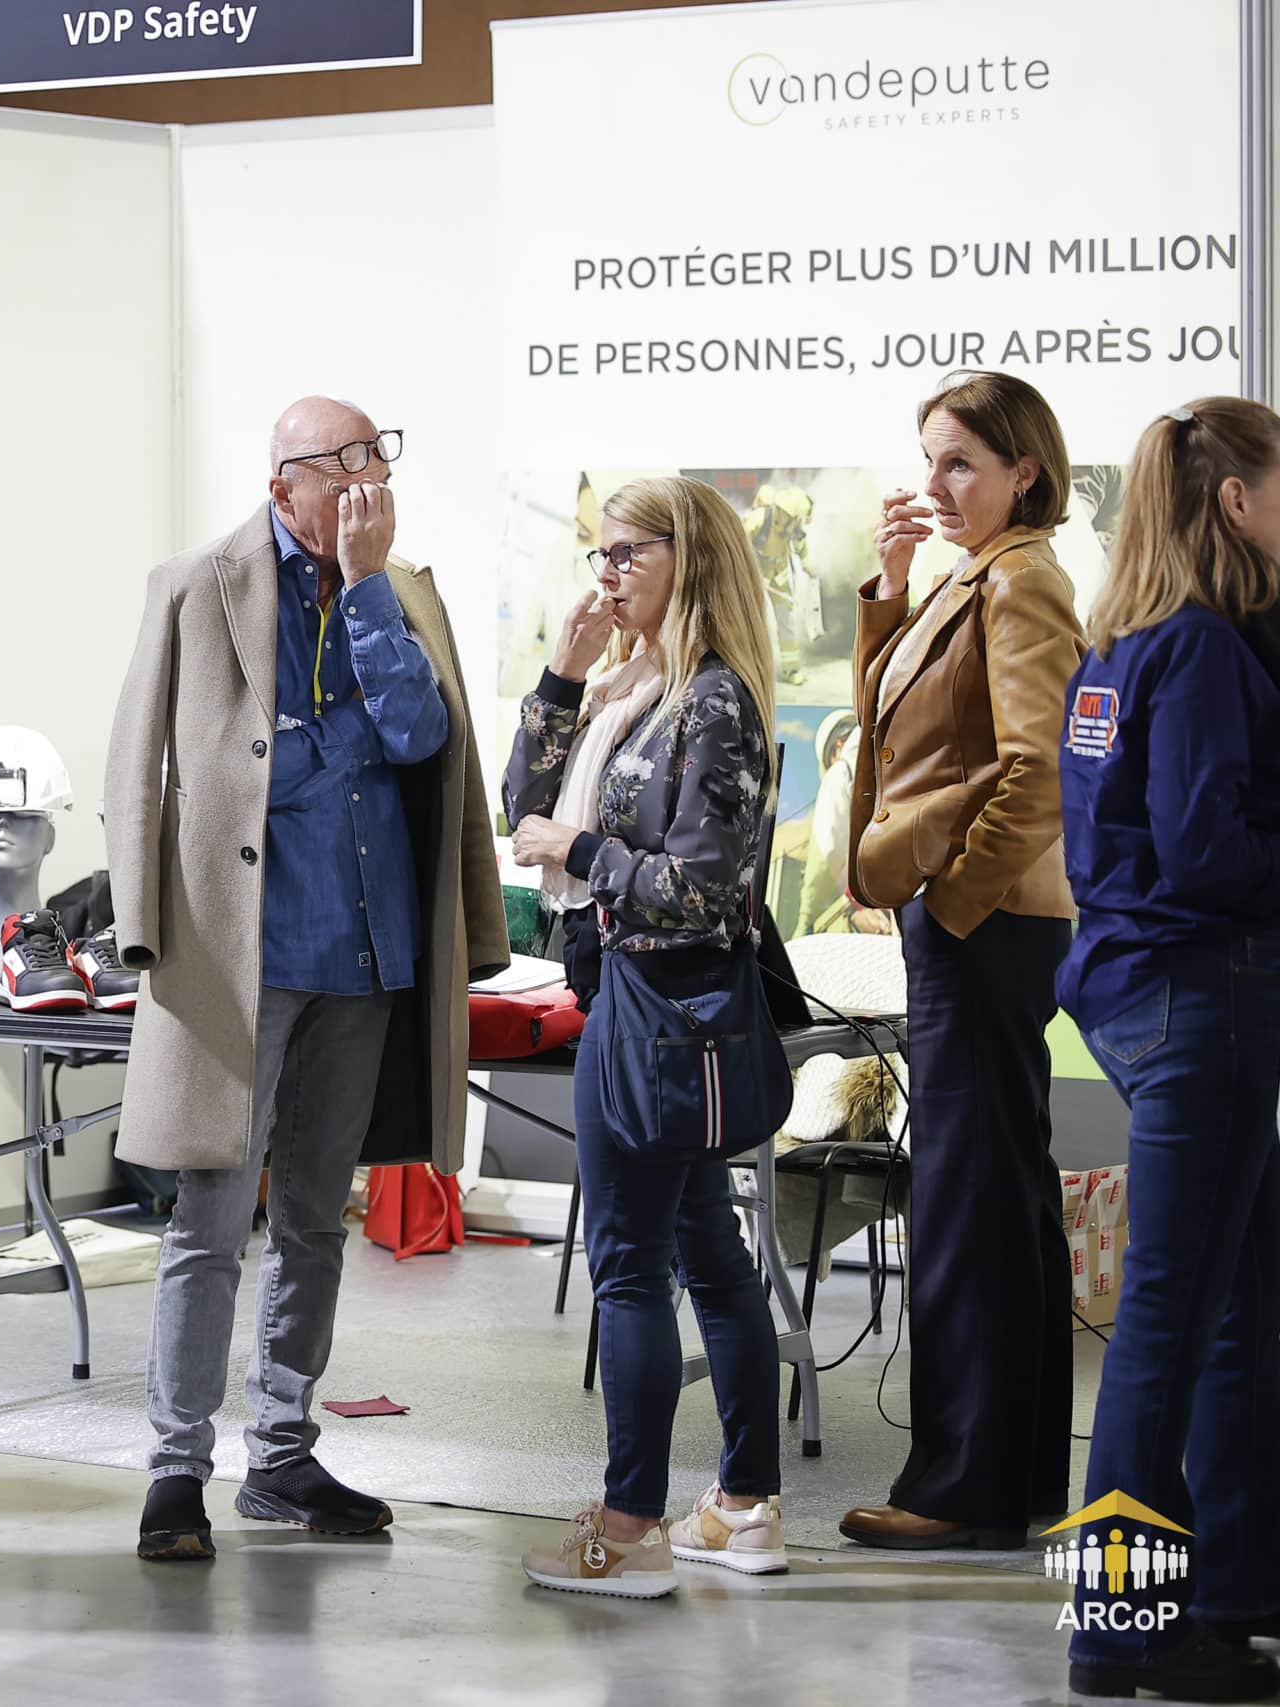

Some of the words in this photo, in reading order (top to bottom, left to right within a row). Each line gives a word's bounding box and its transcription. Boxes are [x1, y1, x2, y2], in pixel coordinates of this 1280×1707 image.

[62, 9, 134, 46] VDP
[143, 1, 257, 44] Safety
[749, 55, 1050, 107] vandeputte
[824, 114, 906, 130] SAFETY
[921, 107, 1021, 126] EXPERTS
[574, 246, 793, 291] PROTÉGER
[809, 246, 913, 283] PLUS
[1049, 234, 1237, 274] MILLION
[528, 343, 579, 376] DE
[596, 336, 856, 375] PERSONNES,
[871, 332, 985, 368] JOUR
[1000, 319, 1153, 364] APRÈS
